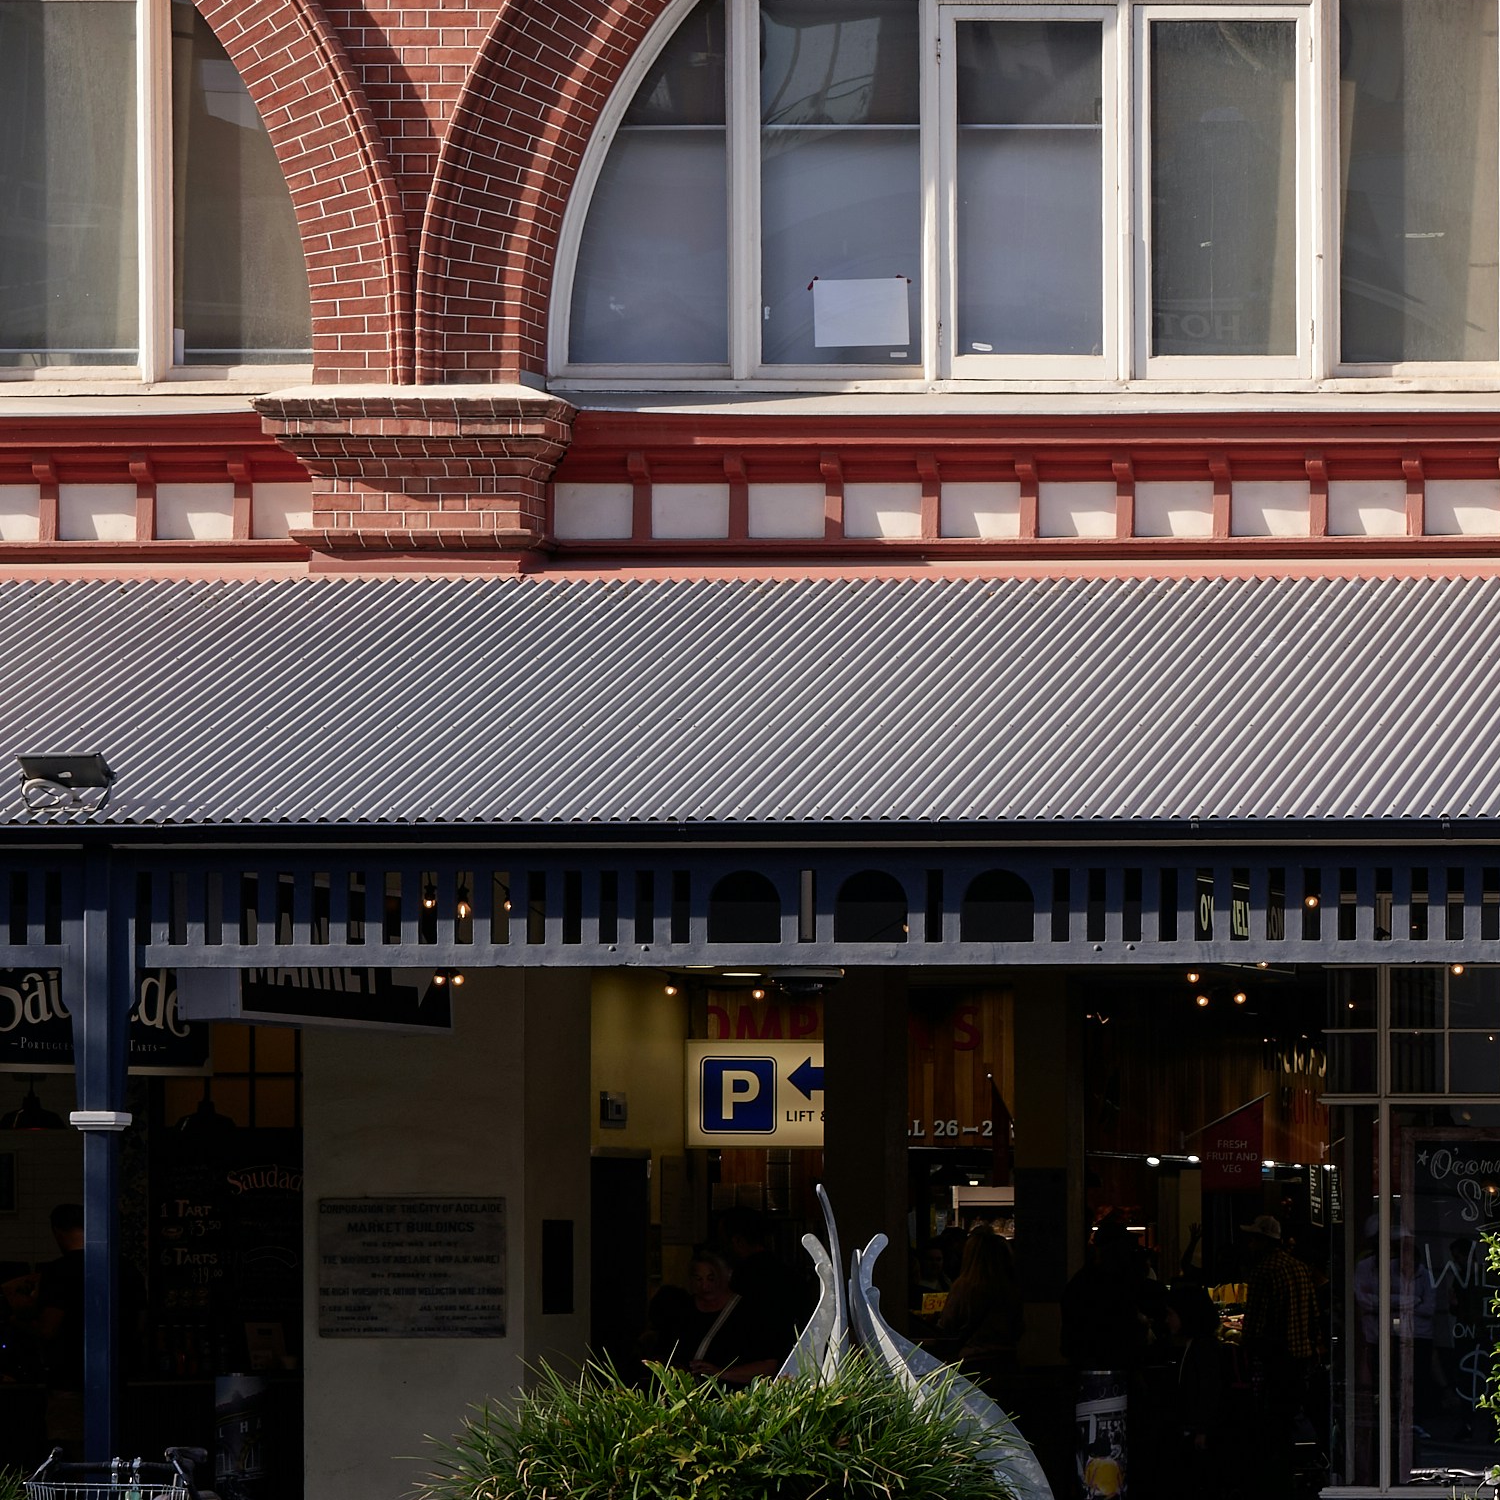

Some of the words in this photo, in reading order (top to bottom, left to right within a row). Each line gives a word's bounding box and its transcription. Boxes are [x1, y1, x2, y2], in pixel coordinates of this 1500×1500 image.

[721, 1070, 761, 1120] P
[786, 1110, 815, 1122] LIFT
[1218, 1140, 1247, 1148] FRESH
[1207, 1152, 1233, 1160] FRUIT
[1236, 1153, 1258, 1161] AND
[1222, 1164, 1242, 1173] VEG
[419, 1203, 442, 1213] CITY
[456, 1203, 502, 1213] ADELAIDE
[347, 1223, 401, 1233] MARKET
[407, 1222, 475, 1233] BUILDINGS
